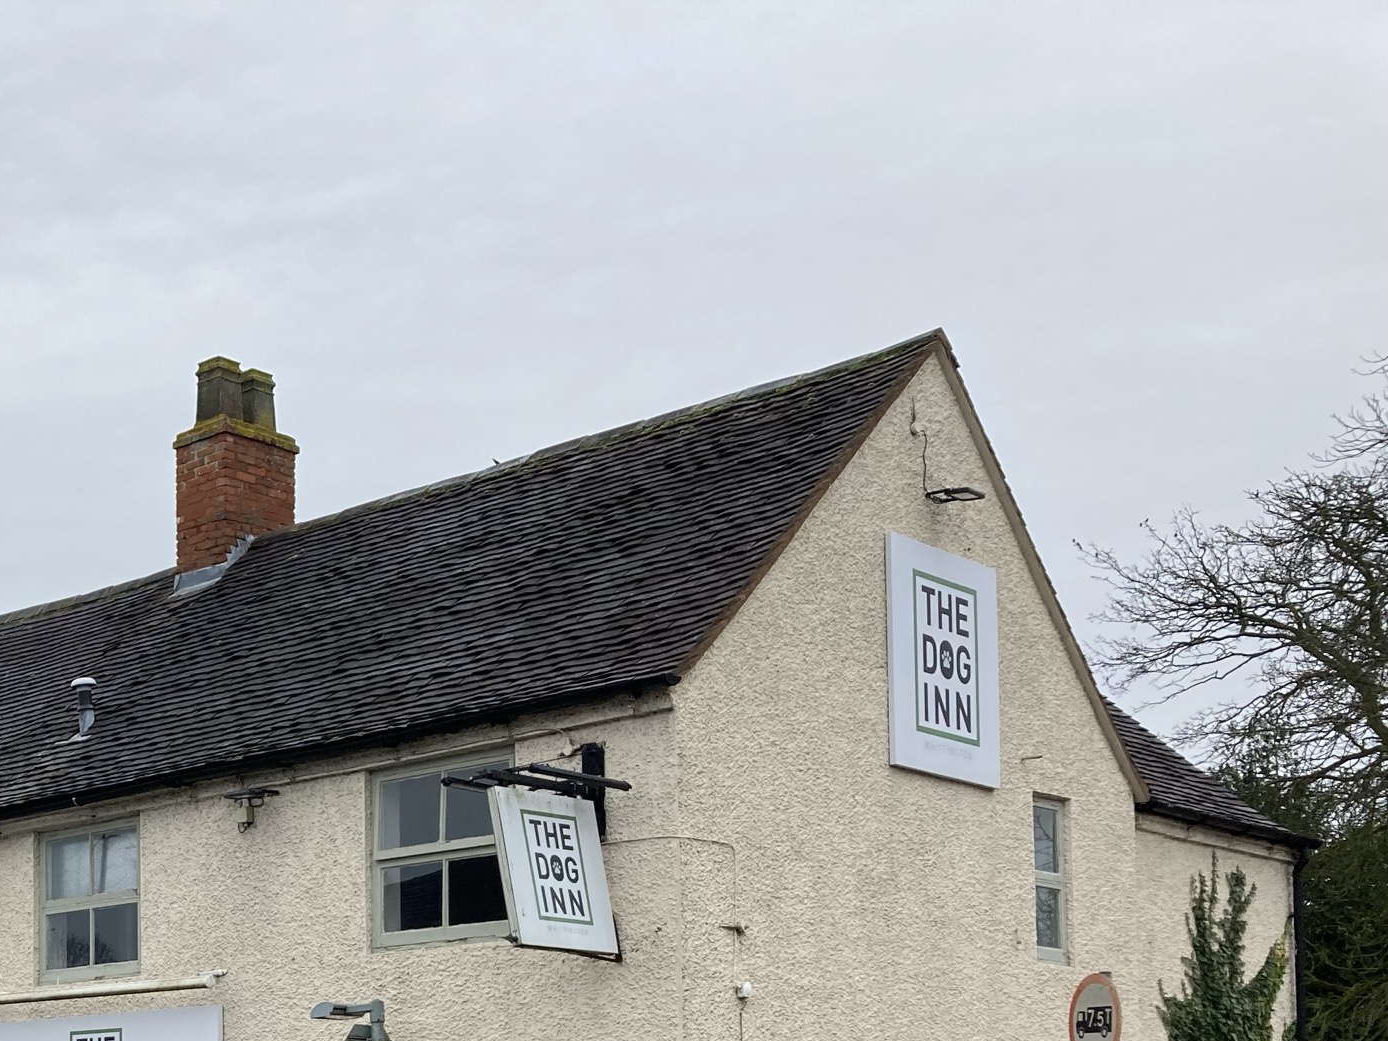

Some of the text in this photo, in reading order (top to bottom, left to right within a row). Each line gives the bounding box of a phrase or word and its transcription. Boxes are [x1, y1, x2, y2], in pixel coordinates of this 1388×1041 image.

[921, 584, 970, 638] THE
[922, 633, 972, 685] DOG
[923, 682, 972, 734] INN
[528, 818, 574, 851] THE
[534, 851, 579, 884] DOG
[540, 885, 586, 917] INN
